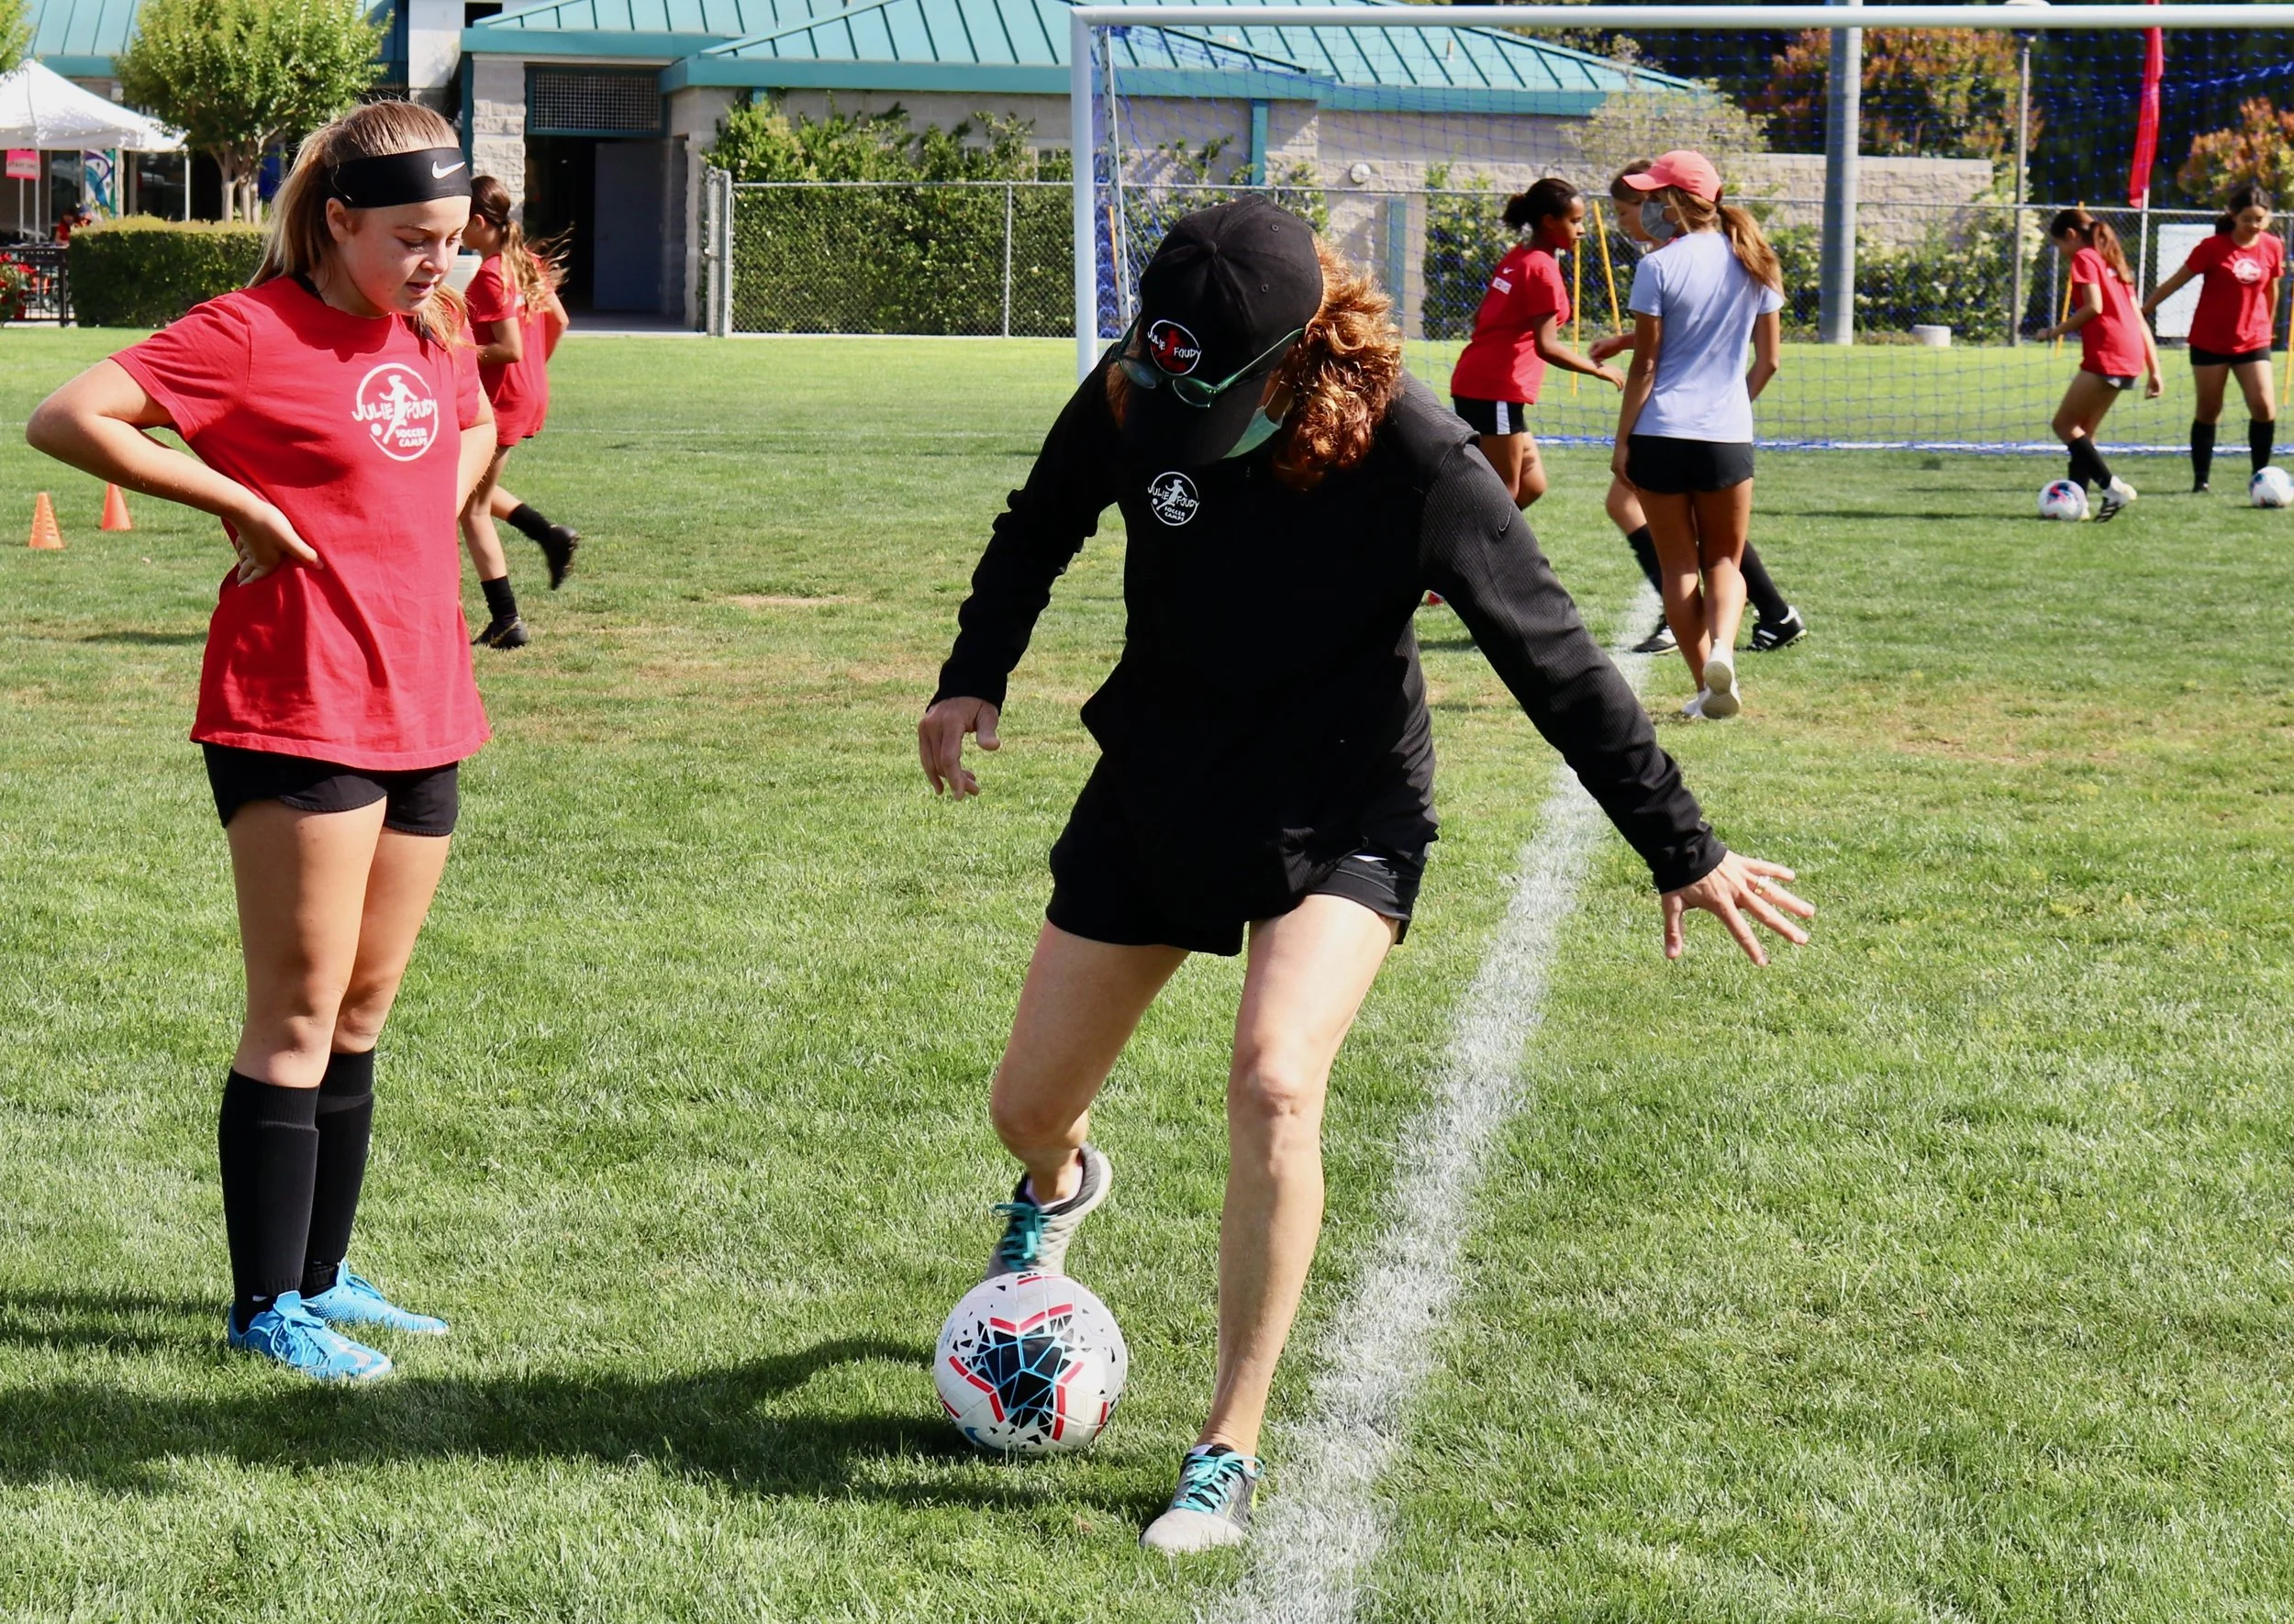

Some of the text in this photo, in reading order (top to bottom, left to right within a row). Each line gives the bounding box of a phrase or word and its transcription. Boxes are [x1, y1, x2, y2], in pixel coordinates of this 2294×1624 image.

[1147, 331, 1202, 359] JULIE FOUDY
[351, 398, 437, 421] JULIE FOUDY
[1147, 486, 1200, 507] JULIE FOUDY
[1164, 506, 1186, 517] SOCCER
[1164, 511, 1185, 522] CAMPS
